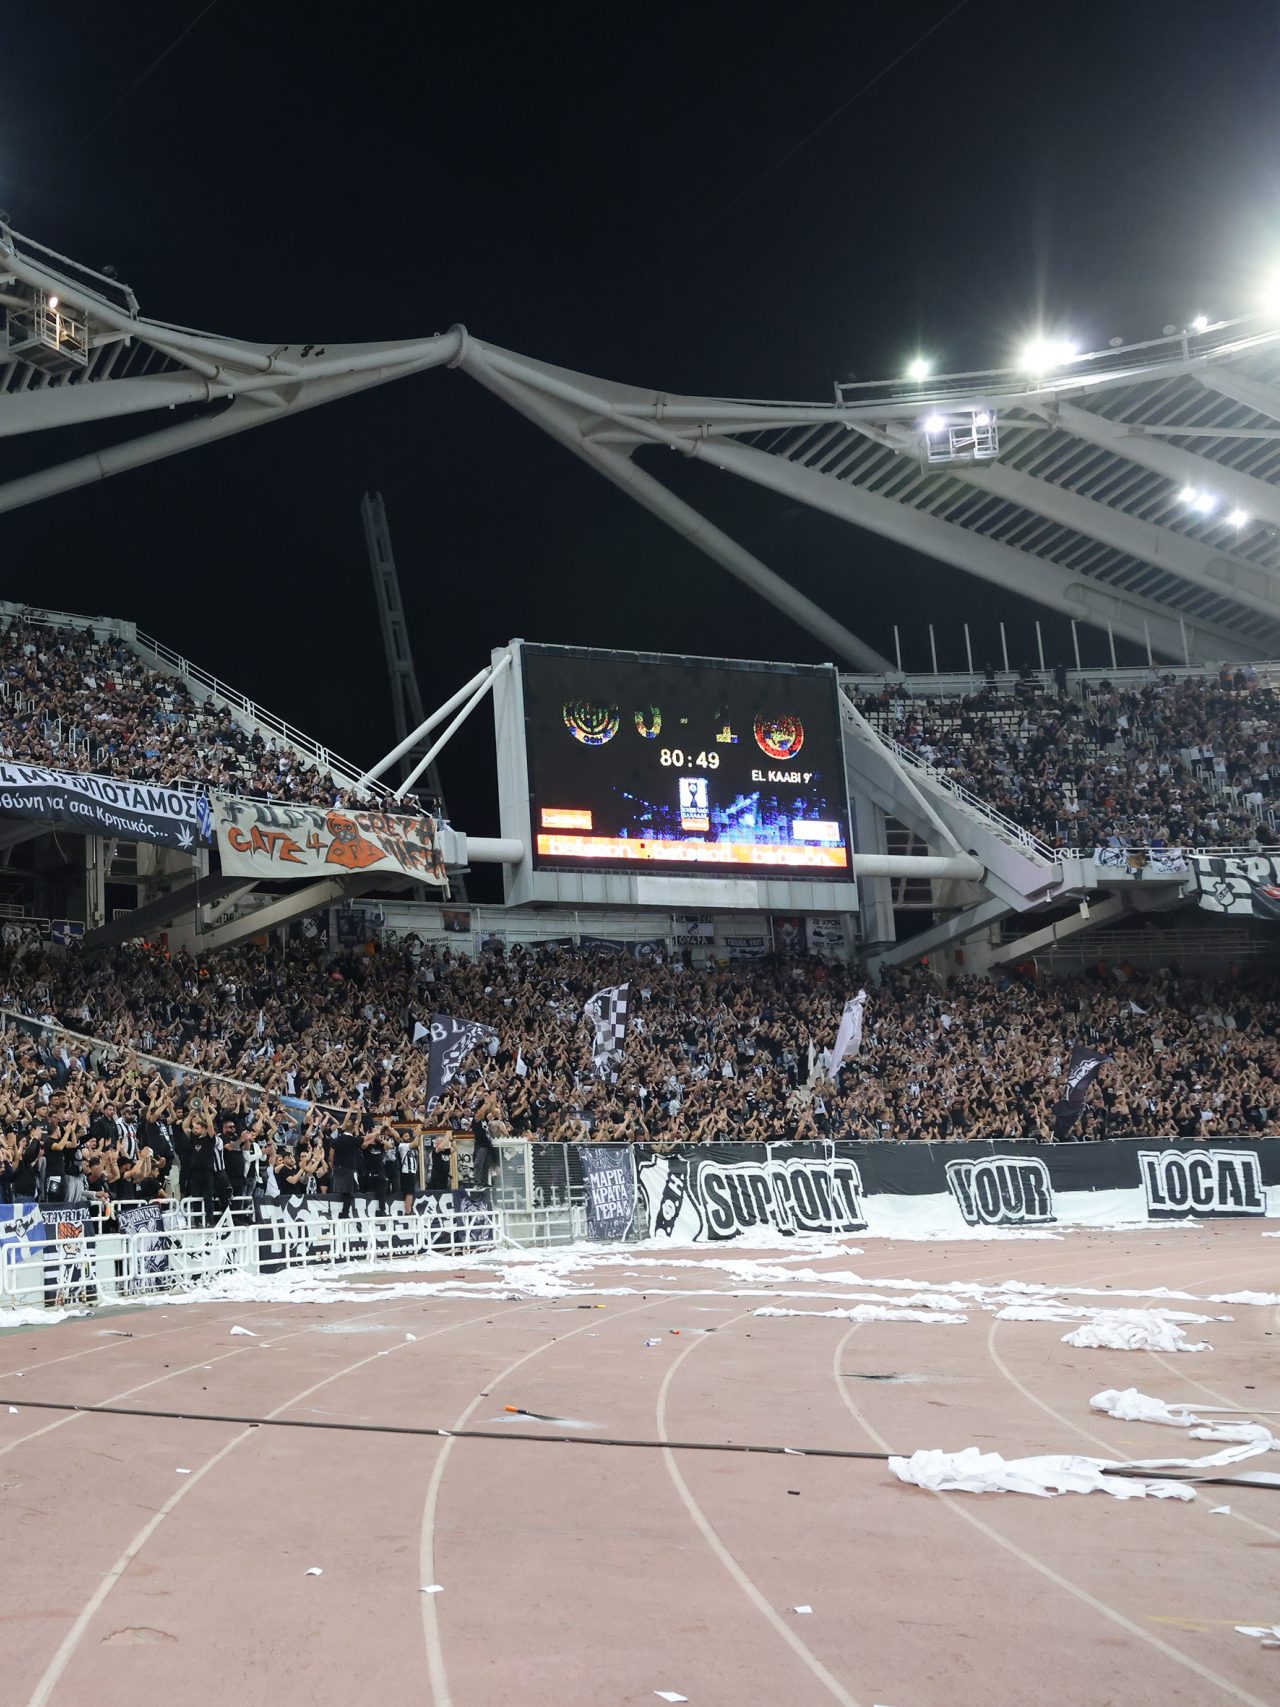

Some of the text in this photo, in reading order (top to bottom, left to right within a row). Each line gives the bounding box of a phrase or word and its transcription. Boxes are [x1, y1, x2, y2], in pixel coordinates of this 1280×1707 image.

[1, 765, 17, 784] 4
[752, 769, 765, 782] EL
[768, 770, 802, 784] KAABI
[70, 800, 95, 817] σαι
[306, 829, 328, 859] 4
[592, 1187, 628, 1206] ΚΡΑΤΑ
[701, 1154, 1264, 1233] SUPPORT YOUR LOCAL
